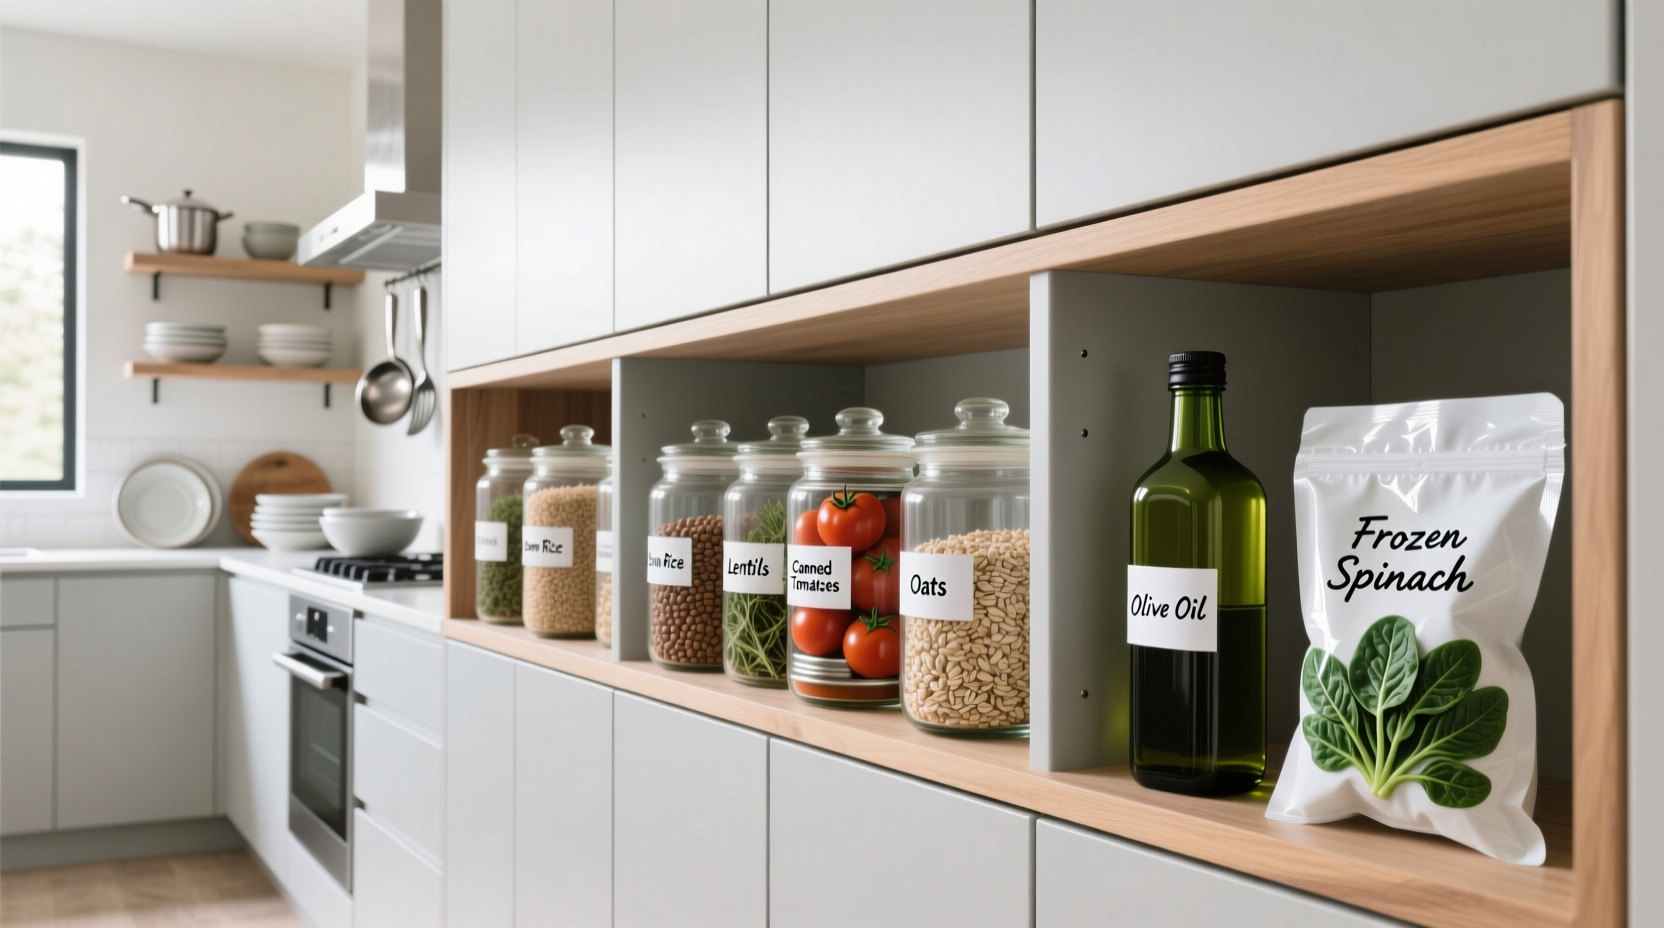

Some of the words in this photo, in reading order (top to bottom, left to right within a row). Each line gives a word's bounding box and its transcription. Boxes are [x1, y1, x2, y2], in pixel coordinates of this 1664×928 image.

[1351, 515, 1467, 551] Frozen
[728, 557, 770, 576] Lentils
[792, 559, 832, 575] Canned
[1326, 554, 1474, 603] Spinach
[910, 573, 947, 597] Oats
[1131, 593, 1170, 618] Olive
[1174, 595, 1207, 620] Oil
